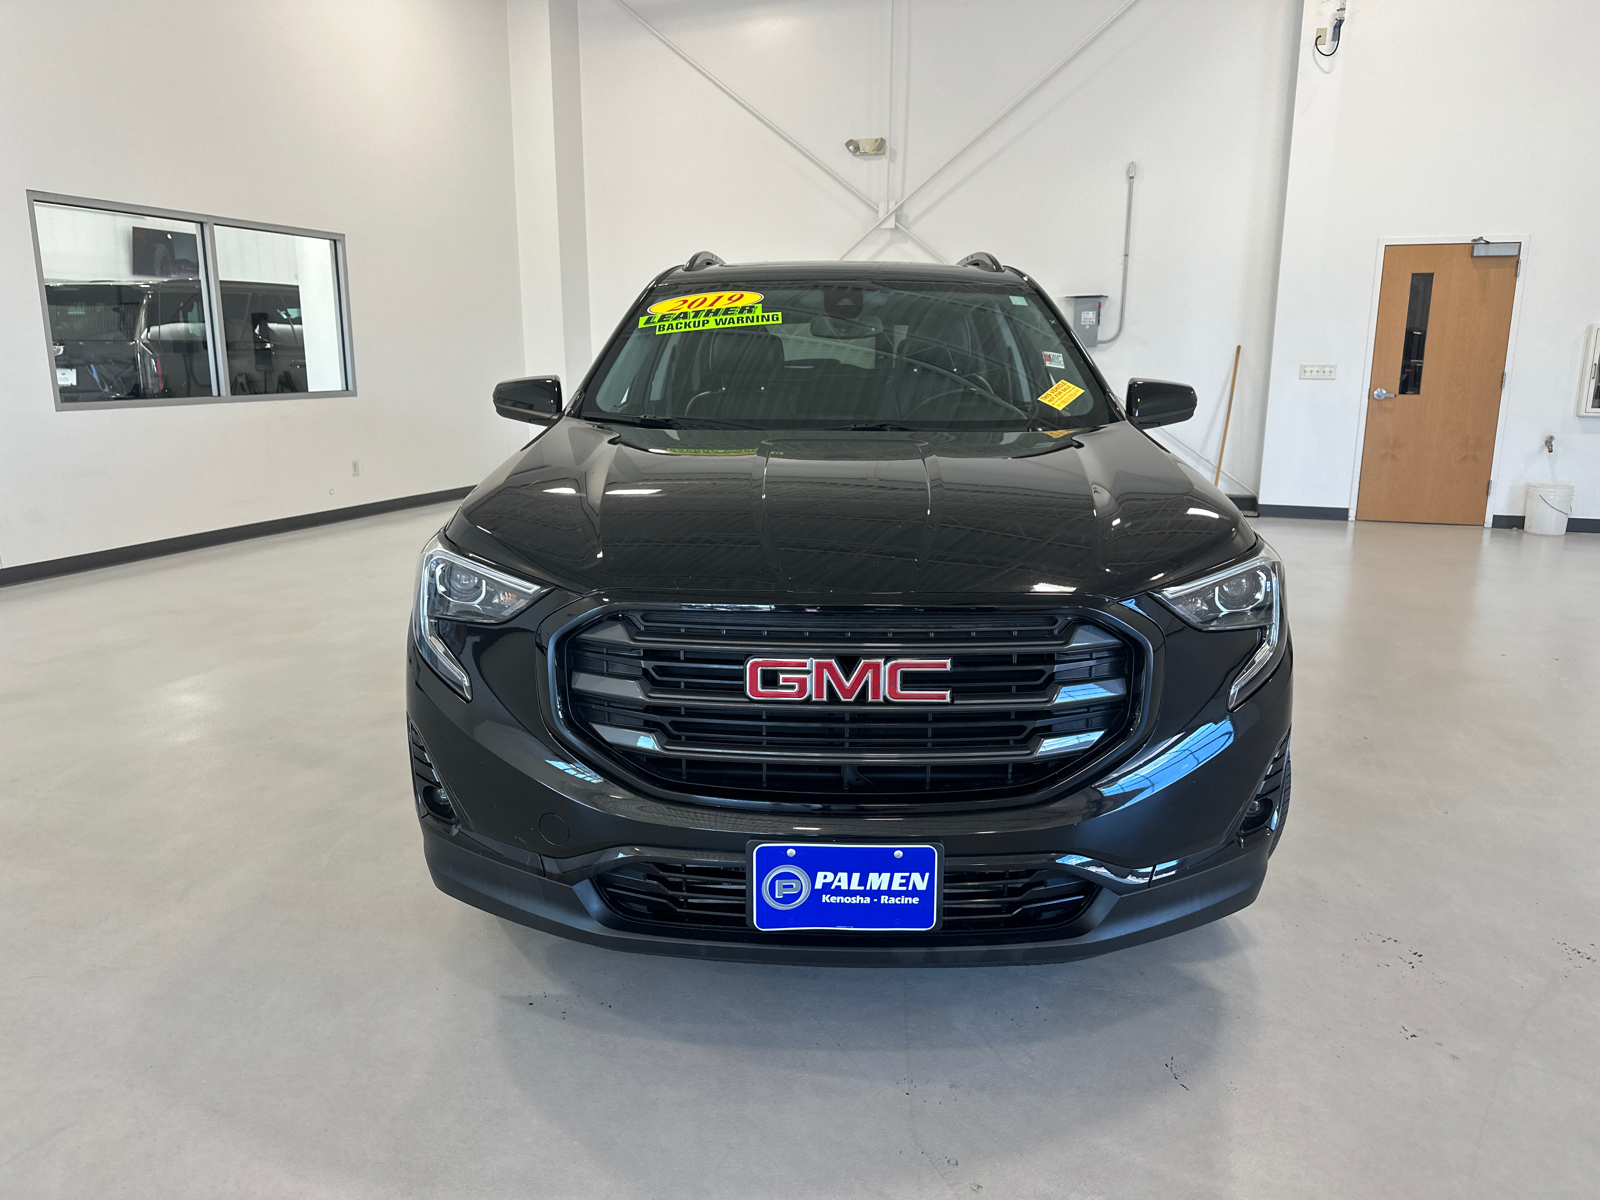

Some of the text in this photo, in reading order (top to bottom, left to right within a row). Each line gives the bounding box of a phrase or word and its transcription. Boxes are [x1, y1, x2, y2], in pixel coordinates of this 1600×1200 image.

[667, 293, 744, 312] 2019
[643, 305, 758, 325] LEATHER
[657, 313, 779, 333] BACKUP WARNING
[745, 657, 952, 702] GMC
[814, 871, 930, 891] PALMEN
[821, 894, 871, 904] Kenosha
[880, 895, 920, 905] Racine
